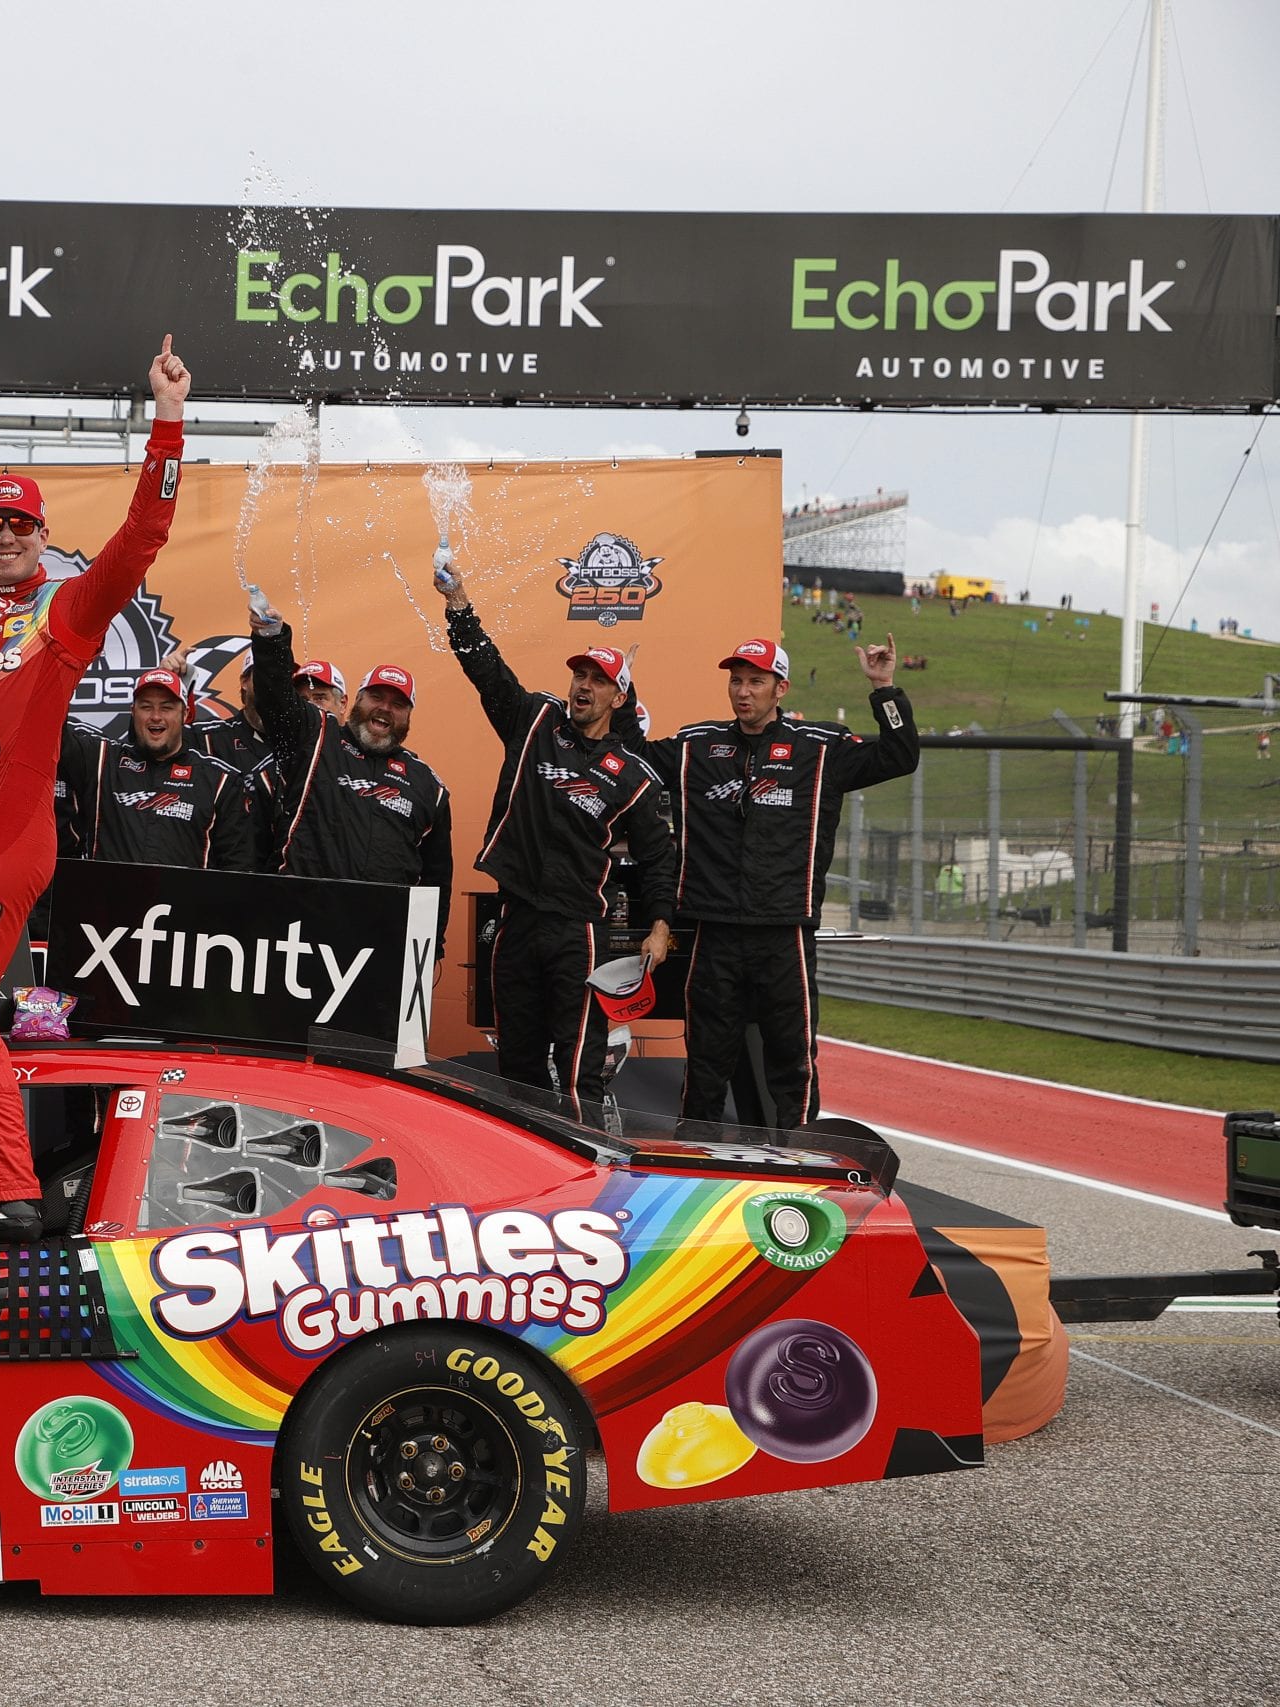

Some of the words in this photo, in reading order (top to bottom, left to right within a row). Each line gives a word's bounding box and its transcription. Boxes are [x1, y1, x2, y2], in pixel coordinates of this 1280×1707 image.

[235, 244, 603, 328] EchoPark
[791, 249, 1175, 333] EchoPark
[856, 356, 1105, 380] AUTOMOTIVE
[581, 568, 601, 577] PIT
[602, 568, 639, 577] BOSS
[571, 586, 647, 605] 250
[754, 799, 792, 807] RACING
[156, 809, 192, 821] RACING
[75, 903, 374, 1024] xfinity
[613, 998, 652, 1016] TRD
[750, 1192, 825, 1208] AMERICAN
[764, 1246, 835, 1268] ETHANOL
[159, 1206, 626, 1328] Skittles
[283, 1276, 603, 1351] Gummies
[53, 1474, 108, 1484] INTERSTATE
[200, 1460, 242, 1482] MAC
[55, 1481, 104, 1491] BATTERIES
[124, 1473, 180, 1486] stratasys
[200, 1481, 243, 1490] TOOLS
[125, 1500, 175, 1512] LINCOLN
[211, 1497, 241, 1505] SHERWIN
[45, 1505, 93, 1521] Mobil
[137, 1511, 180, 1521] WELDERS
[300, 1461, 363, 1576] EAGLE
